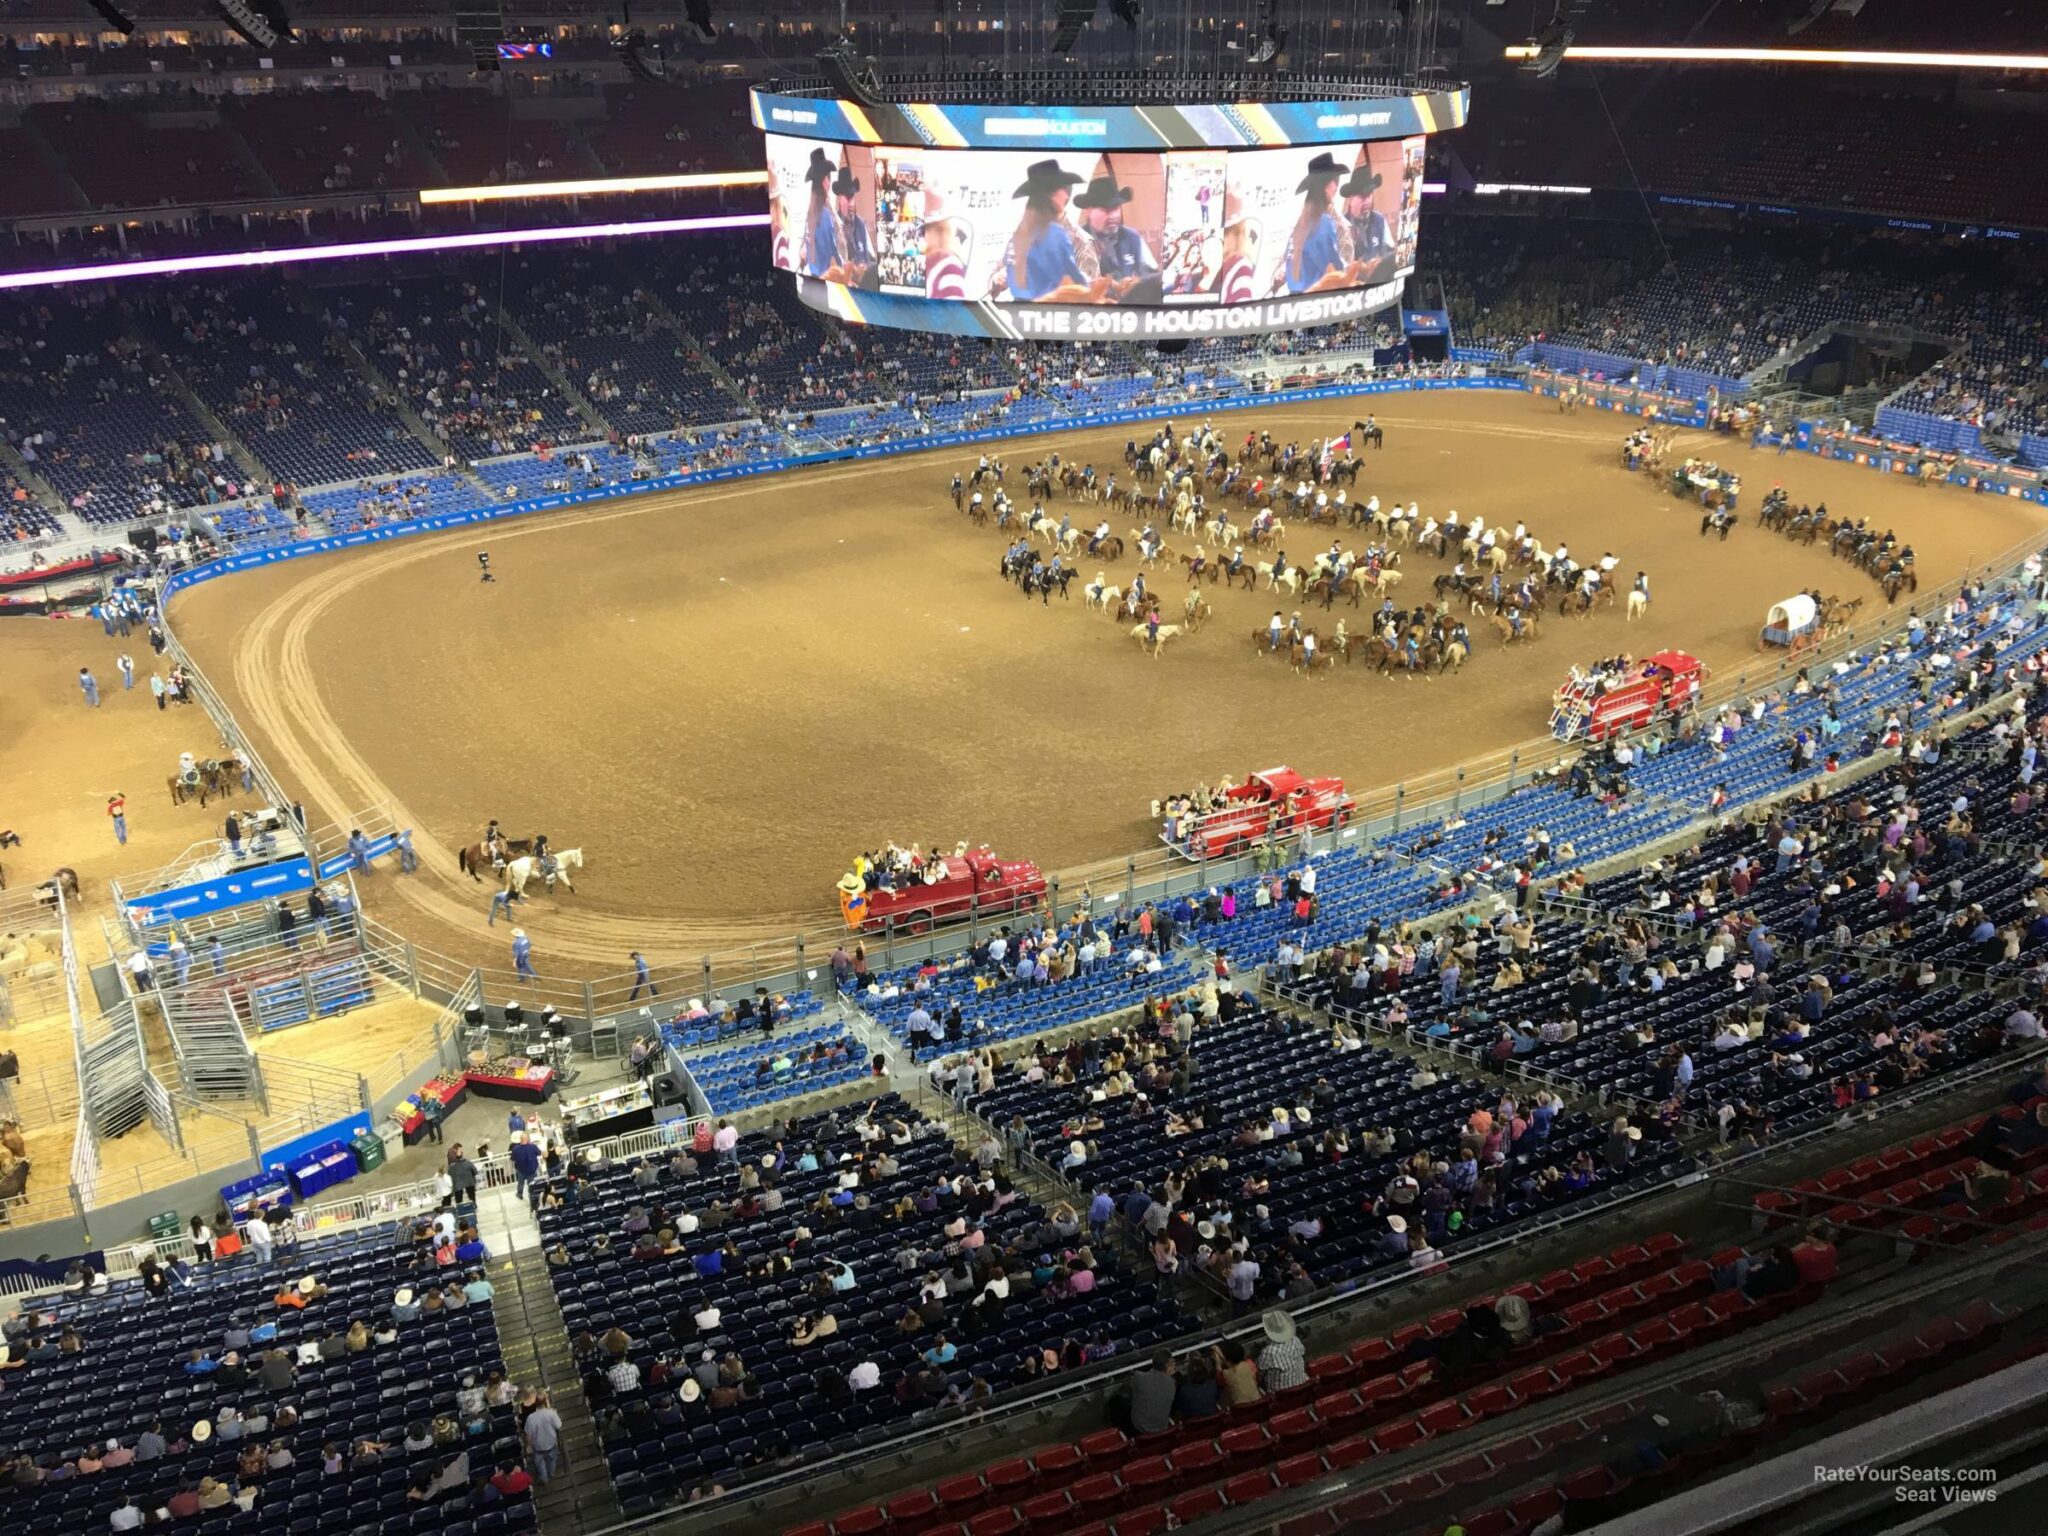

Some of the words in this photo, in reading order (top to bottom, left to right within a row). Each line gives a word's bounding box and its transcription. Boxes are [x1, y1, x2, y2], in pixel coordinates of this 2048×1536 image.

[1019, 310, 1071, 333] THE
[1076, 311, 1138, 334] 2019
[1145, 305, 1262, 333] HOUSTON
[1267, 291, 1363, 326] LIVESTOCK
